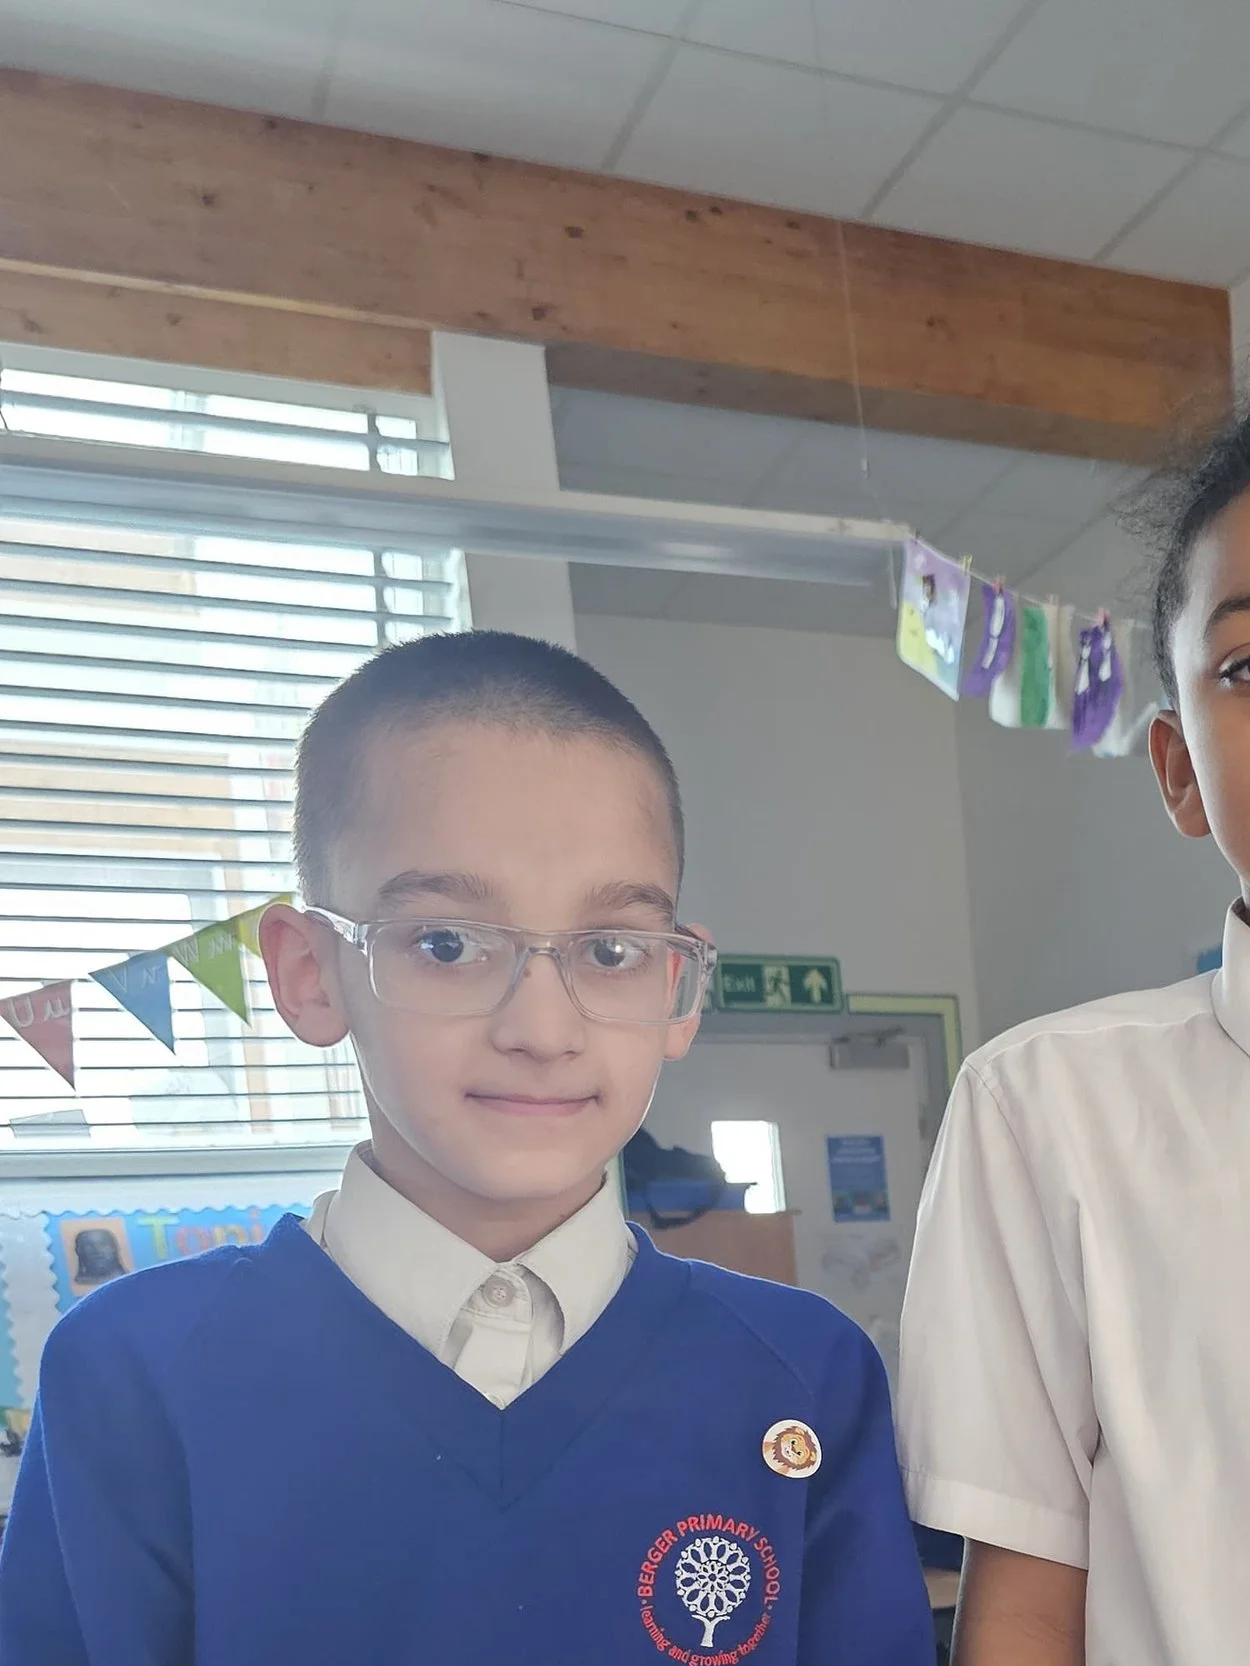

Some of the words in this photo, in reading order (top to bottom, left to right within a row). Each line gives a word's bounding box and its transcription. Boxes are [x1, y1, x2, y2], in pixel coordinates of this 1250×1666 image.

[137, 1206, 265, 1262] Toni
[637, 1528, 679, 1597] BERGER
[676, 1514, 759, 1542] PRIMARY
[753, 1536, 781, 1604] SCHOOL
